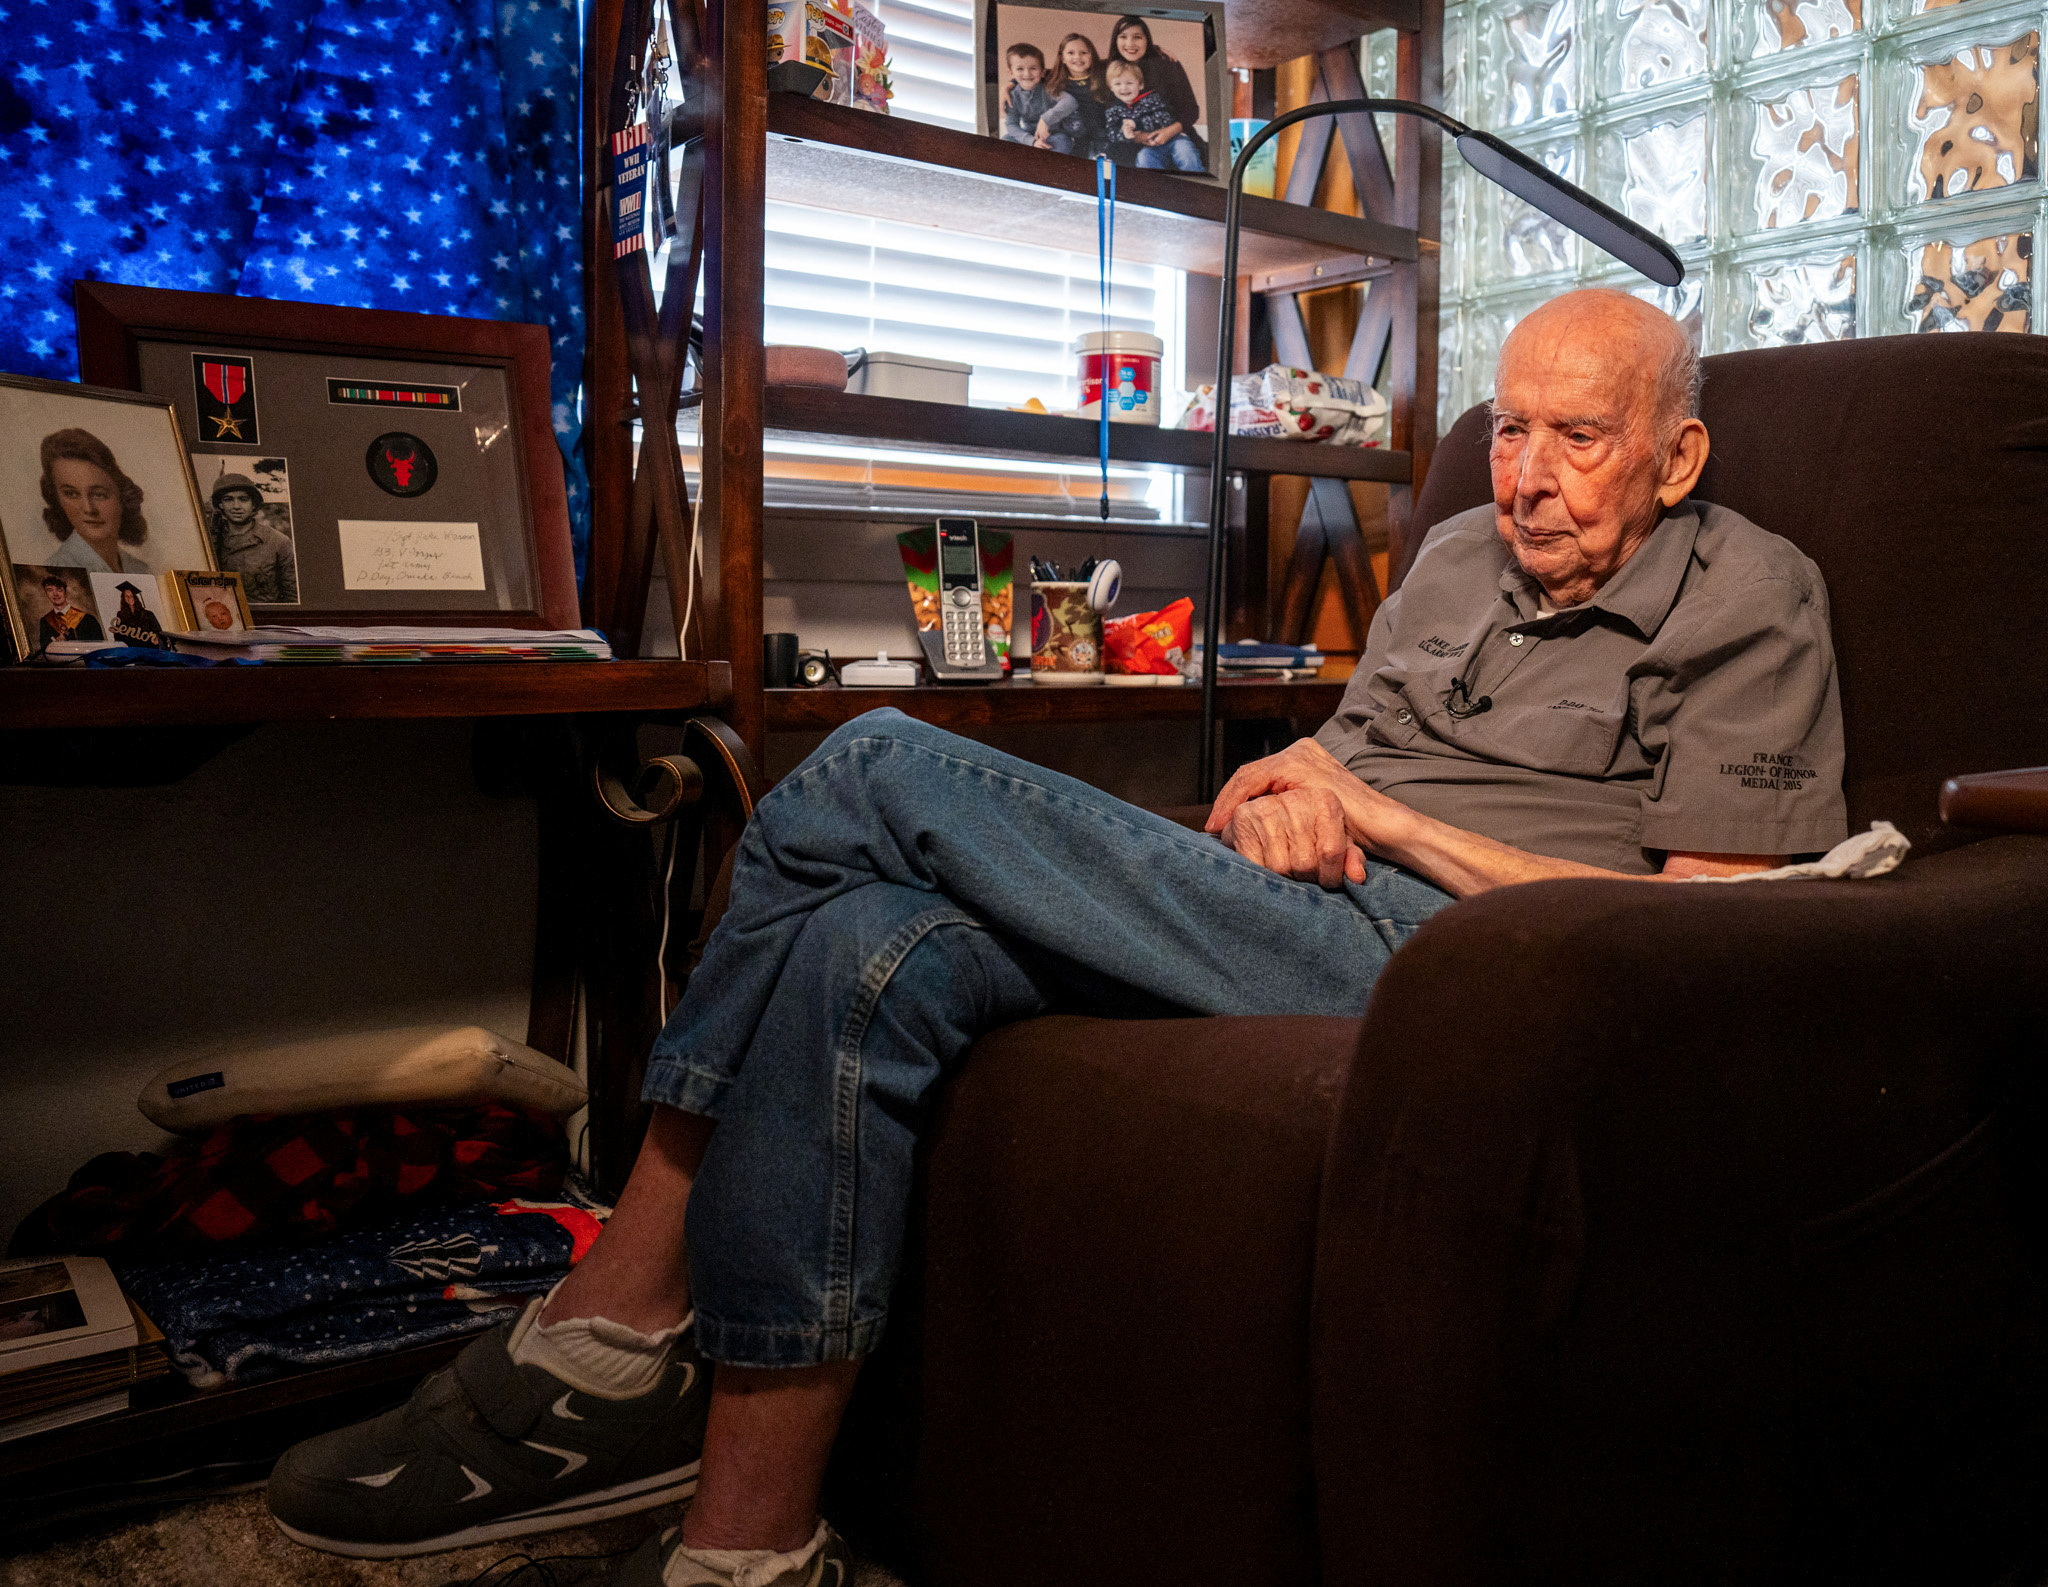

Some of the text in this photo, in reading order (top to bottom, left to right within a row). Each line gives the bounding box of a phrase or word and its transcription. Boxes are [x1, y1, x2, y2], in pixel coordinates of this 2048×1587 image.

[618, 164, 646, 185] VETERAN
[108, 616, 159, 646] Senior
[1427, 635, 1450, 650] JAKE
[1753, 752, 1793, 766] FRANCE
[1769, 766, 1782, 778] OF
[1783, 768, 1818, 779] HONOR
[1741, 777, 1802, 791] MEDAL 2015
